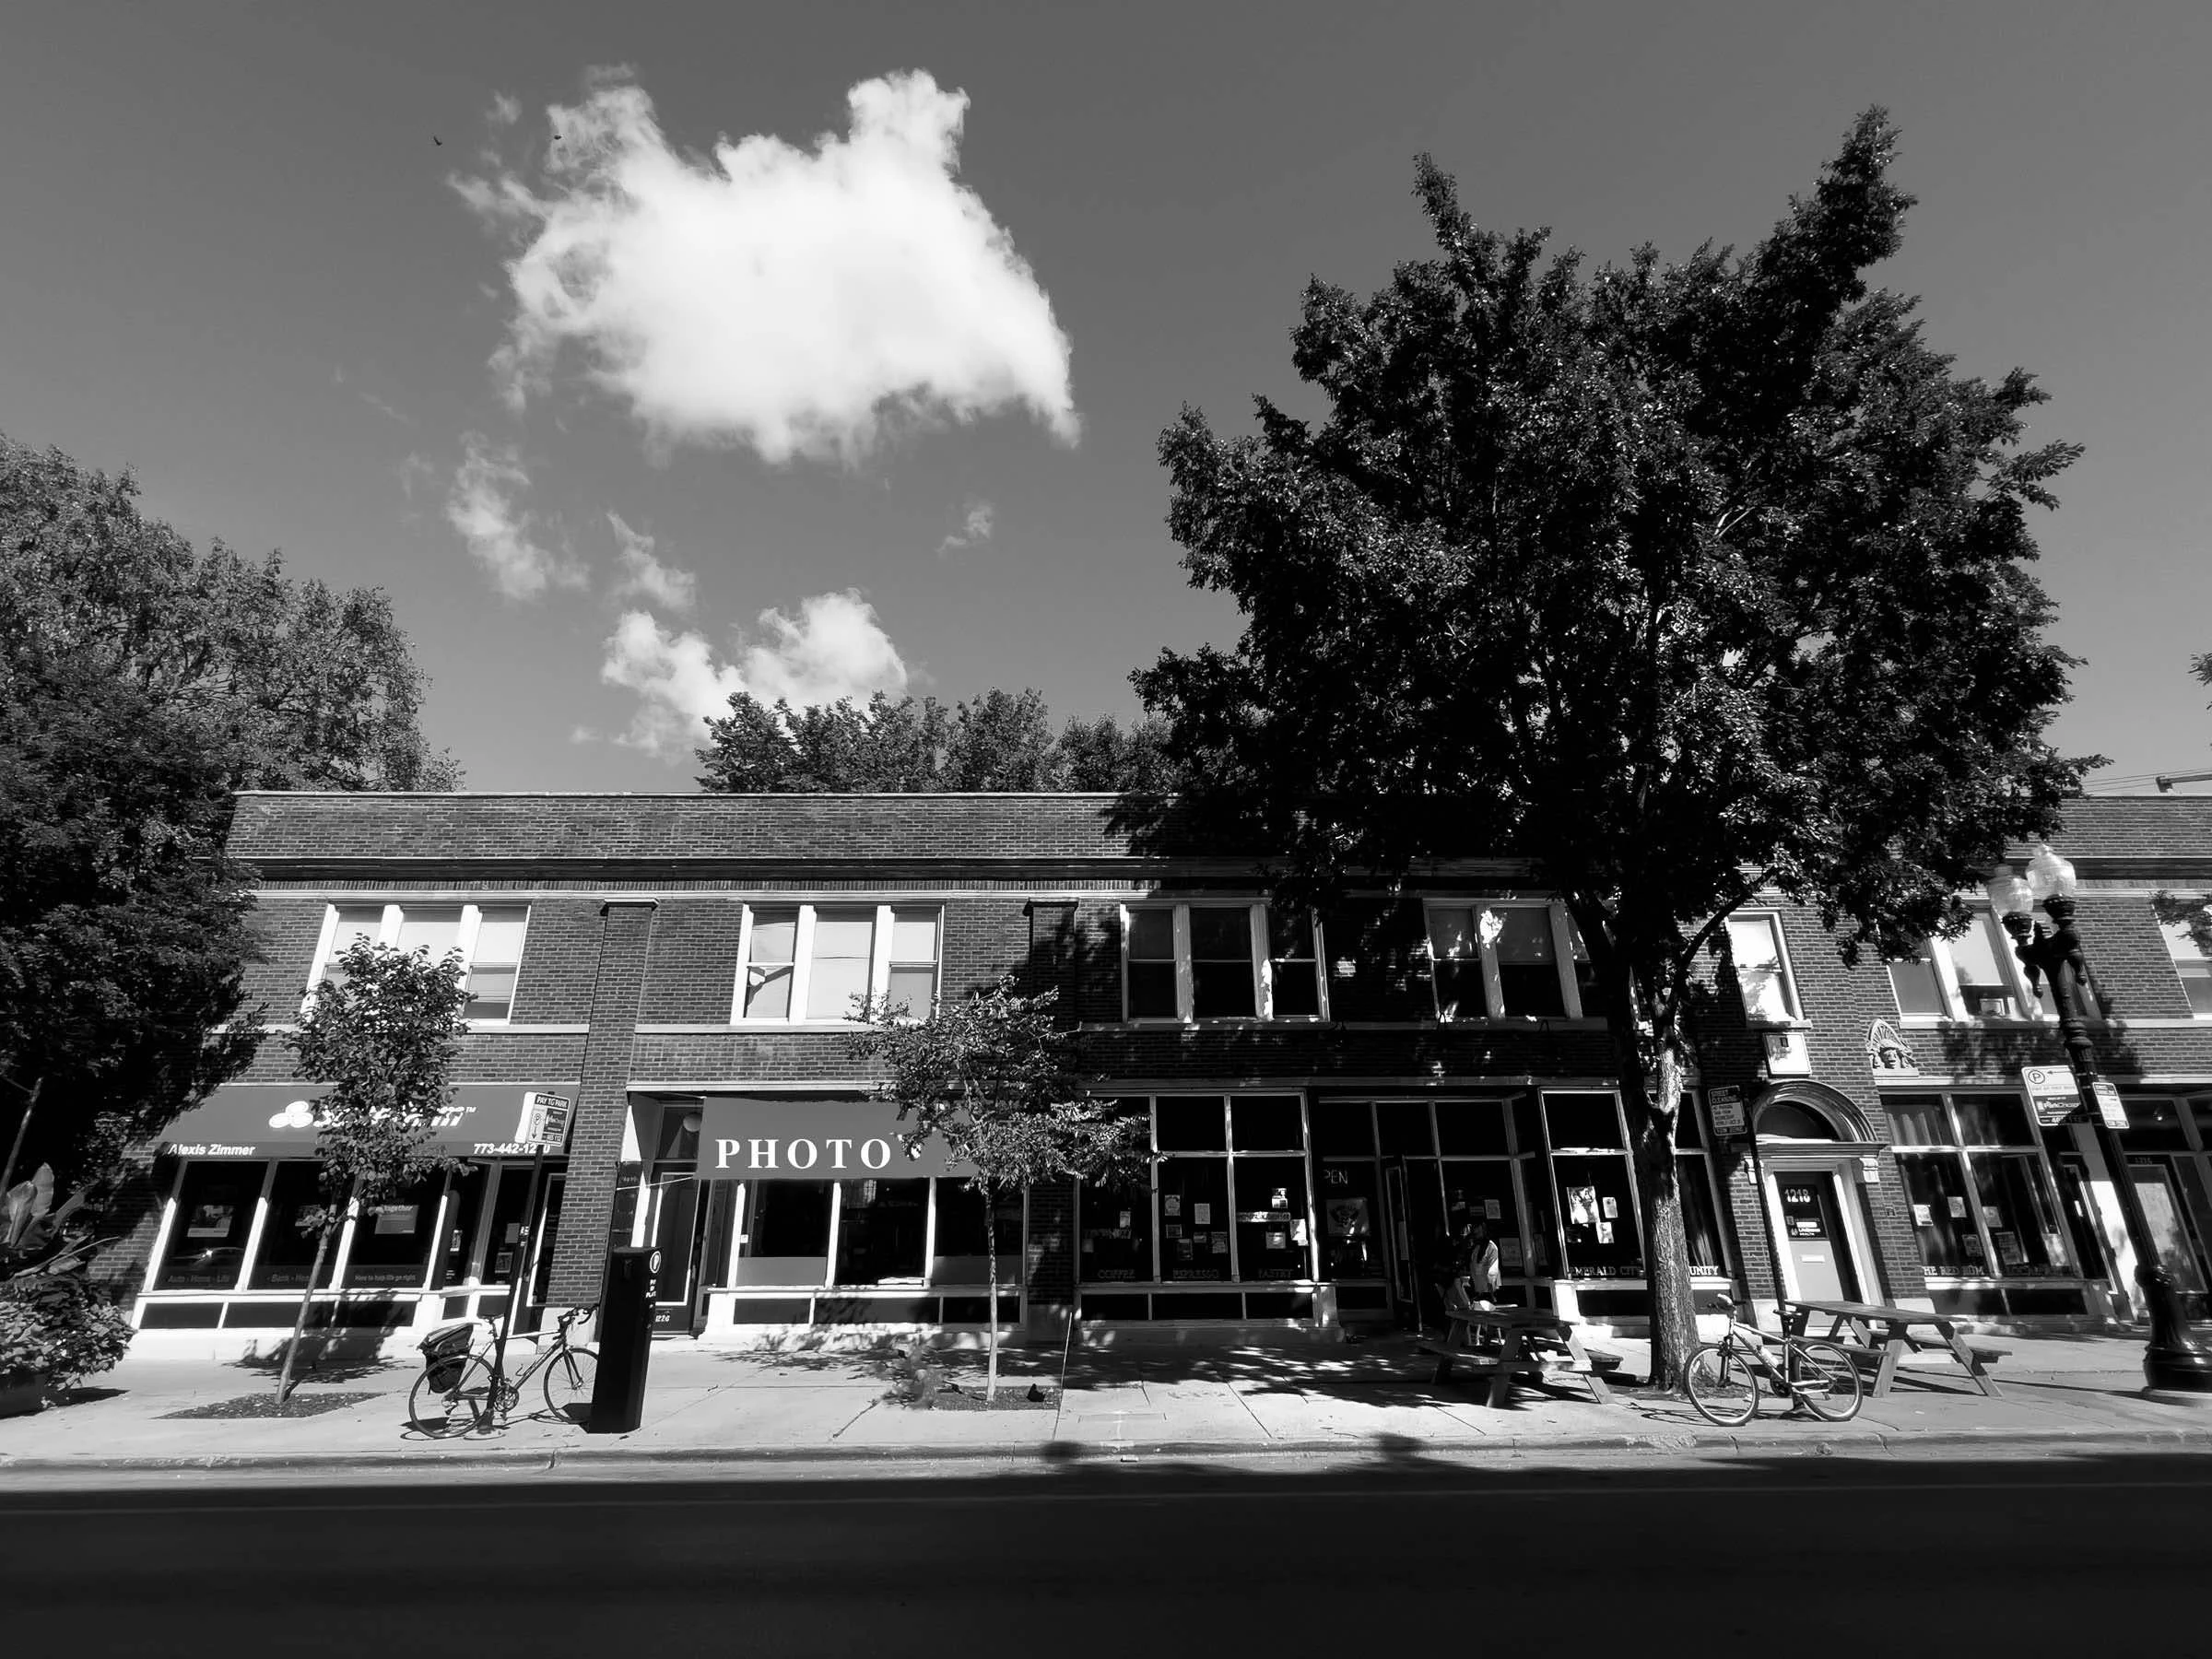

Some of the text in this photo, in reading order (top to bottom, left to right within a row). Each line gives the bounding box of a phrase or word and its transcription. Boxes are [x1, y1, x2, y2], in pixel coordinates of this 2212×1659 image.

[167, 1143, 256, 1156] Alexis Zimmer
[473, 1143, 551, 1154] 773-442-120
[714, 1138, 891, 1170] PHOTO
[1322, 1168, 1349, 1185] PEN
[1784, 1188, 1811, 1203] 1218
[1688, 1265, 1719, 1276] UNITY
